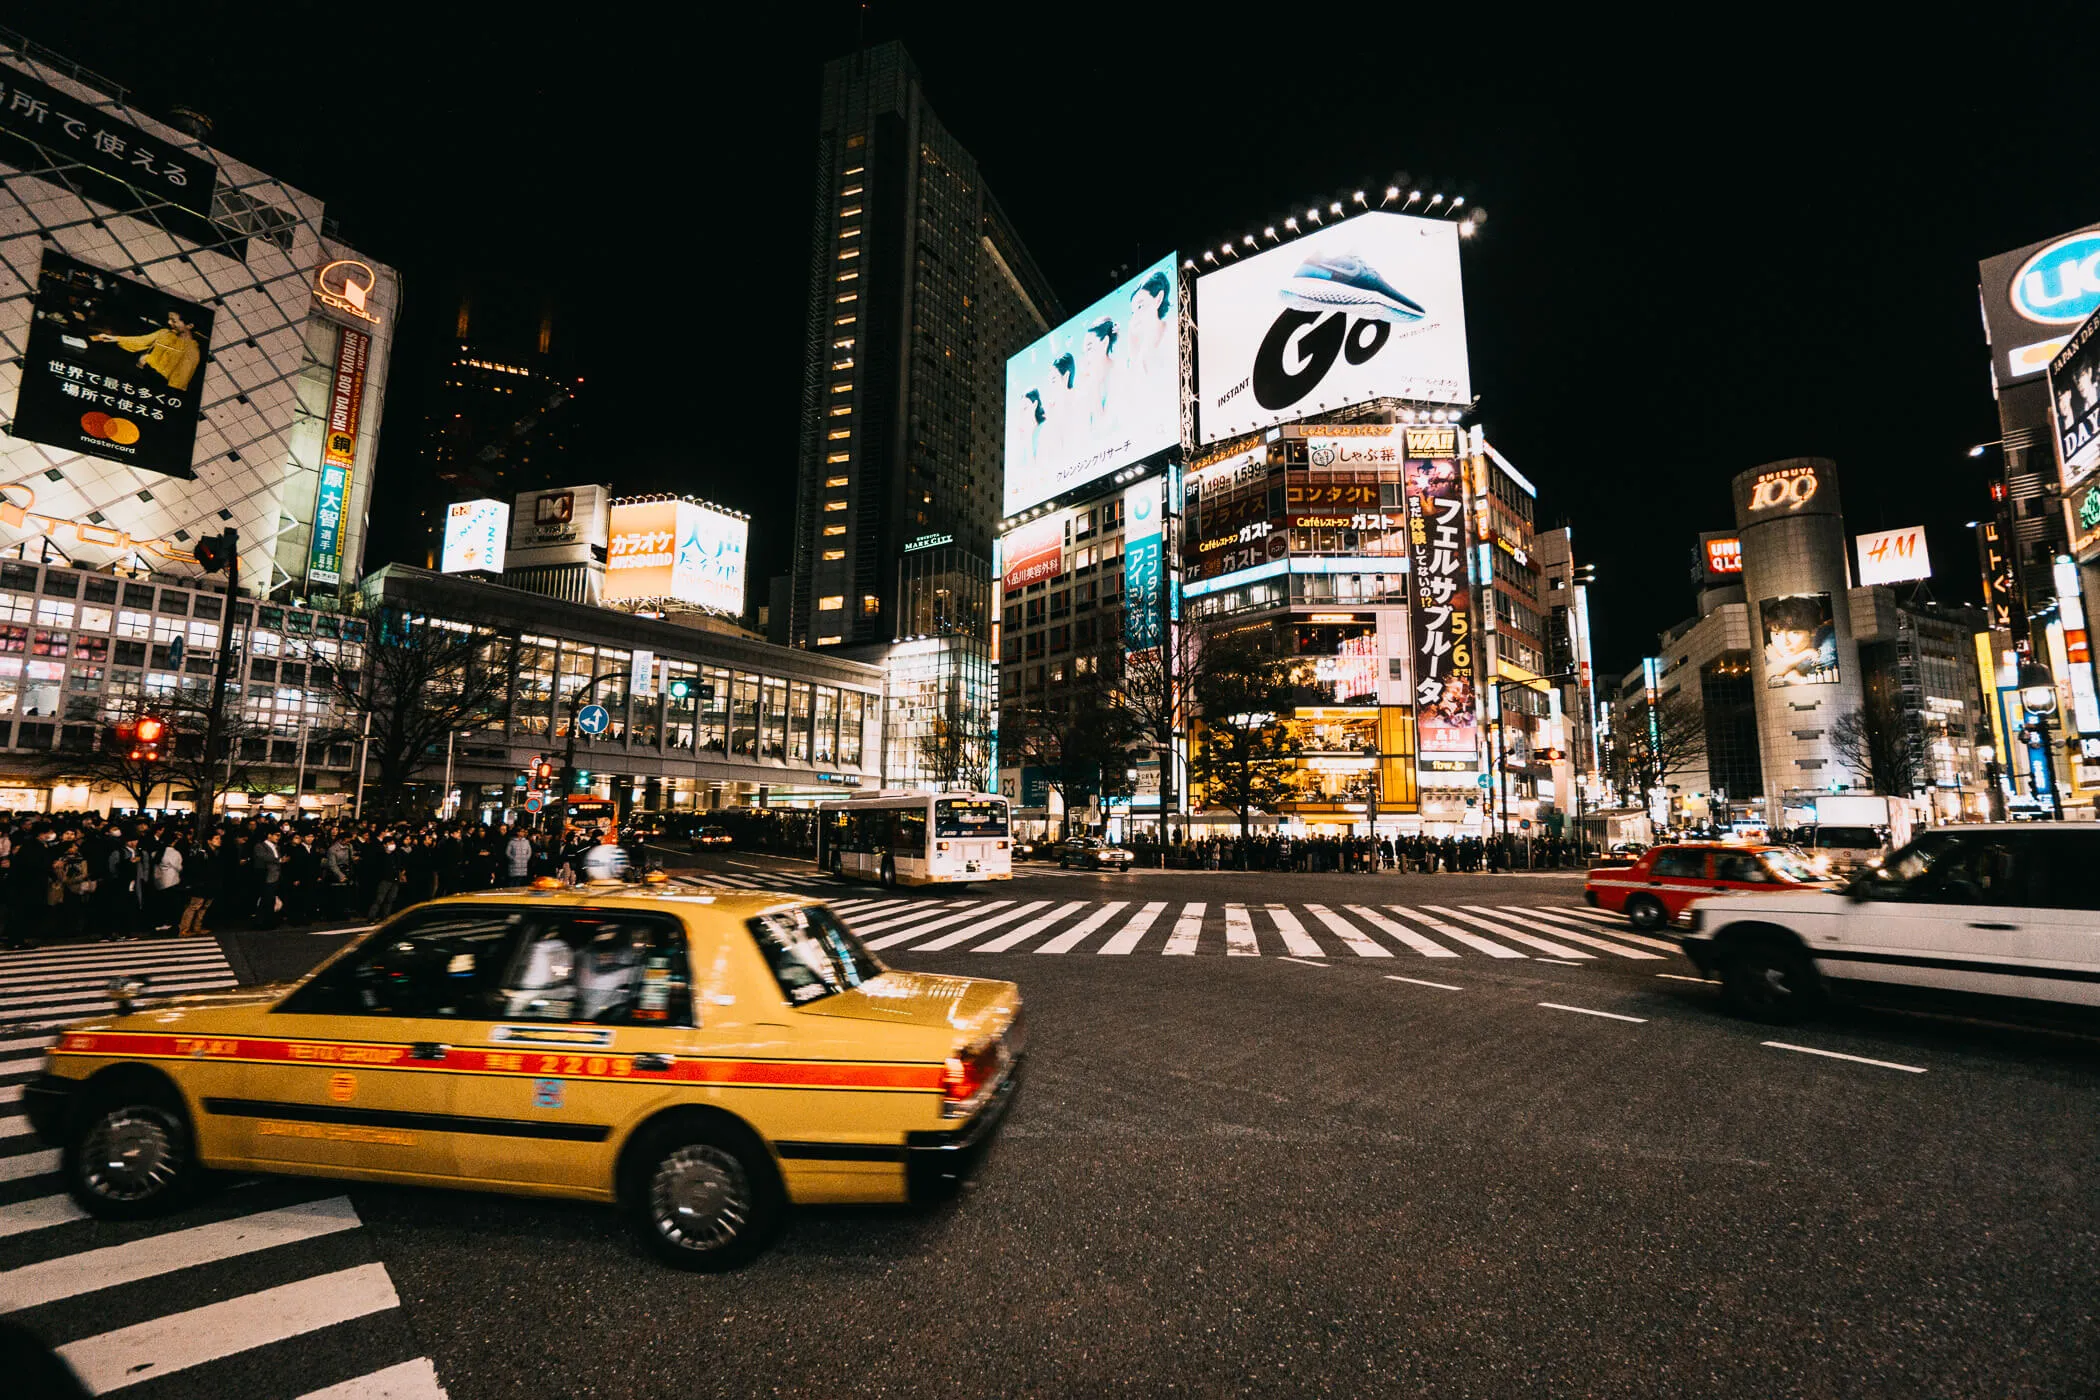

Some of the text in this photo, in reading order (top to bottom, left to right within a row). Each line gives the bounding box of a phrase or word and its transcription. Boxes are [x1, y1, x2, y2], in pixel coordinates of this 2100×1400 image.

[0, 82, 187, 186] 所で使える
[339, 331, 359, 373] SHIBUYA
[2053, 313, 2100, 375] JAPAN DER
[48, 360, 182, 409] 世界で最も多くの
[337, 375, 353, 397] BOY
[1217, 377, 1250, 408] INSTANT
[62, 382, 164, 420] 場所で使える
[332, 397, 350, 431] DAICHI
[1299, 425, 1394, 437] しゃぶしゃぶバイキング
[80, 436, 136, 454] mastercard
[1758, 467, 1815, 483] SHIBUYA
[1186, 483, 1199, 497] 9F
[1288, 486, 1376, 502] コンタクト
[1748, 474, 1818, 511] 109
[1239, 521, 1272, 543] ガスト
[1351, 514, 1394, 530] ガスト
[611, 531, 674, 555] カラオケ
[904, 534, 952, 550] MARK CITY
[1867, 533, 1916, 564] H&M
[1011, 559, 1058, 586] 品川美容外科
[1187, 565, 1200, 578] 7F
[1223, 547, 1262, 573] ガスト
[1146, 543, 1158, 638] コンタクトの
